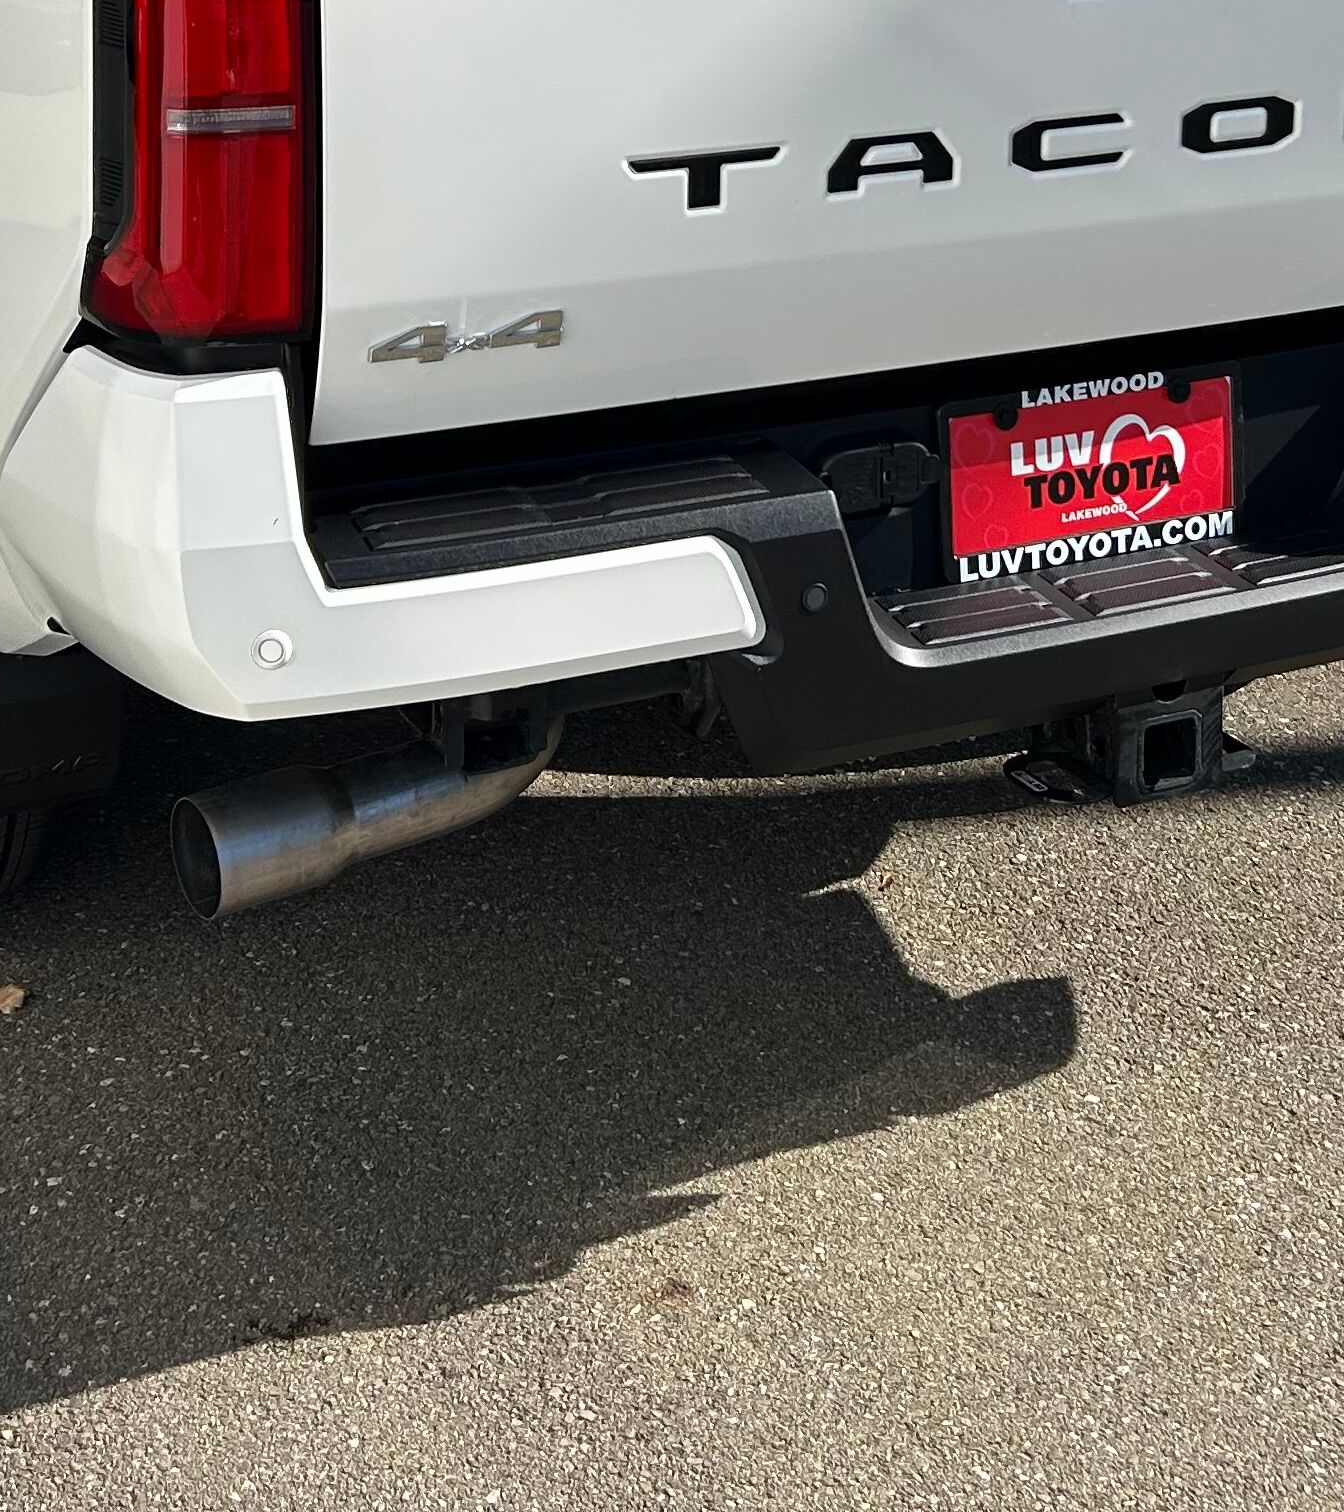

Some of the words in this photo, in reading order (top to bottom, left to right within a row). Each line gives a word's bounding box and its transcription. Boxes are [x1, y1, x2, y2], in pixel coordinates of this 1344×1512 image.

[1021, 371, 1165, 409] LAKEWOOD
[1010, 430, 1095, 477] LUV
[1024, 454, 1181, 509] TOYOTA
[1061, 503, 1128, 523] LAKEWOOD
[959, 511, 1234, 583] LUVTOYOTA.COM
